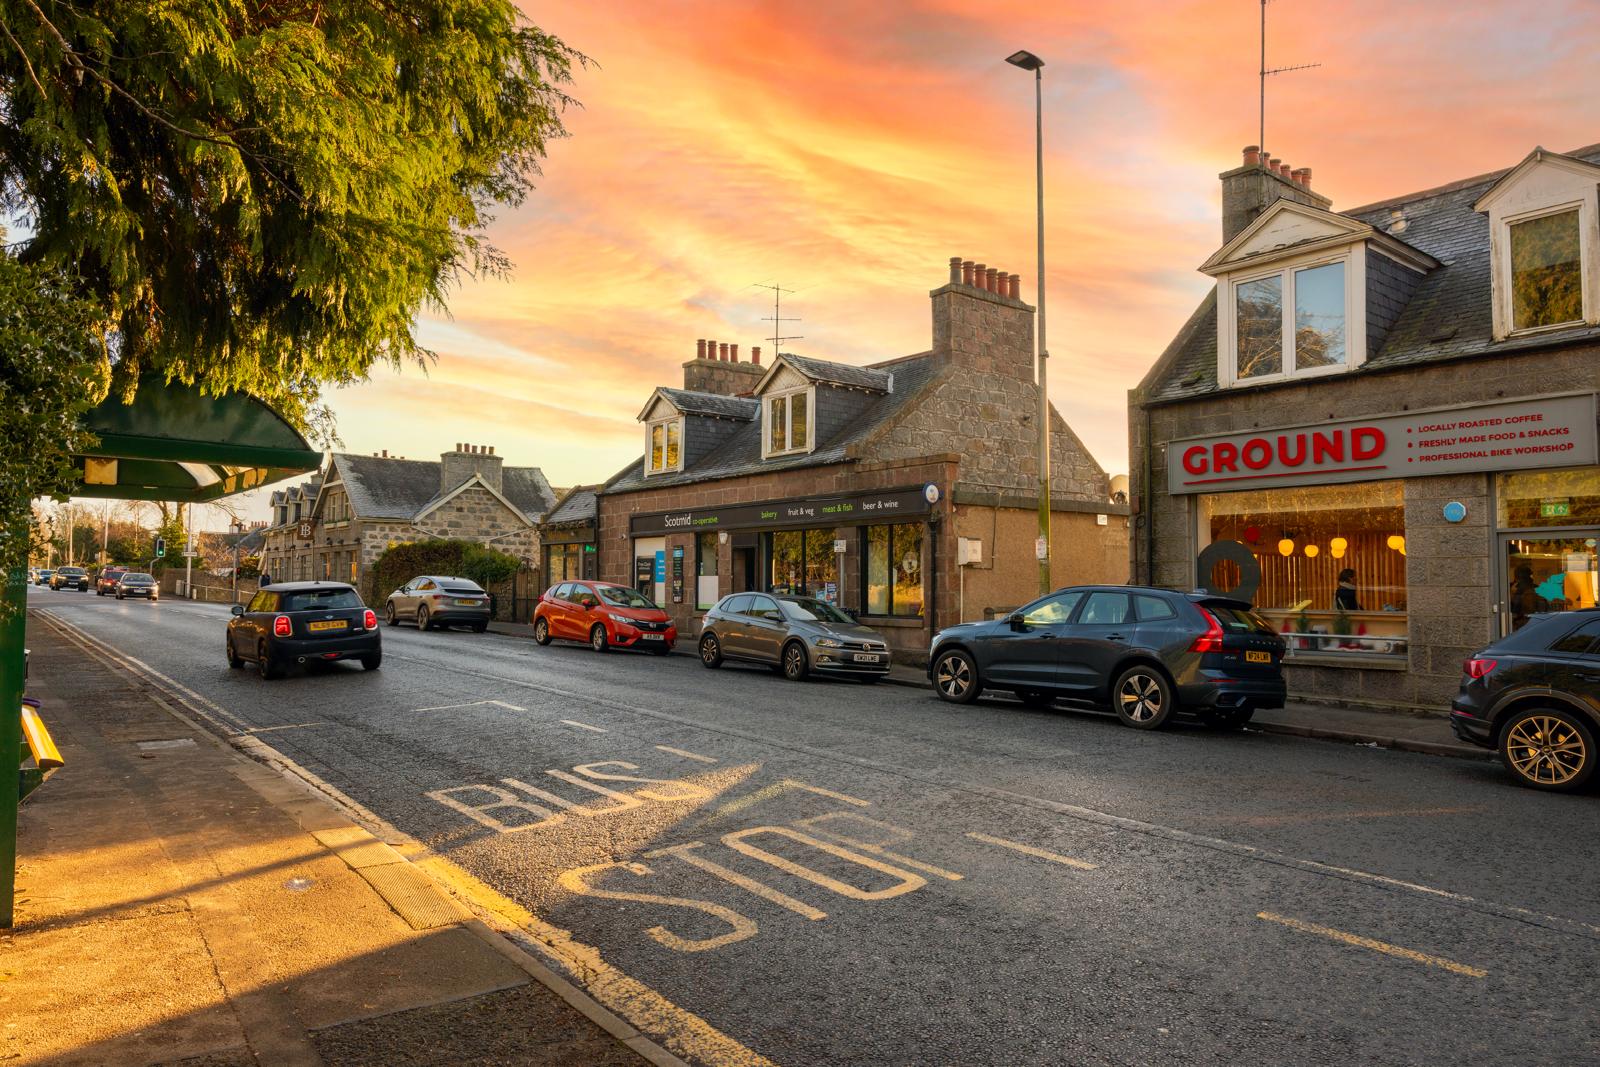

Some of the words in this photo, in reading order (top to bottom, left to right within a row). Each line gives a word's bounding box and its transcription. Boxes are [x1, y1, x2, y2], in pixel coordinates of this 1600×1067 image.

[1418, 423, 1456, 433] LOCALLY
[1458, 418, 1502, 429] ROASTED
[1504, 413, 1543, 424] COFFEE
[1418, 438, 1457, 448] FRESHLY
[1459, 435, 1486, 444] MADE
[1488, 432, 1516, 441] FOOD
[1519, 431, 1526, 439] &
[1528, 427, 1569, 438] SNACKS
[1182, 427, 1386, 475] GROUND
[1419, 450, 1489, 462] PROFESSIONAL
[1490, 448, 1512, 457] BIKE
[1515, 442, 1574, 455] WORKSHOP
[787, 508, 799, 516] fruit
[805, 508, 814, 517] veg
[843, 503, 853, 512] fish
[862, 501, 876, 510] beer
[877, 500, 883, 509] &
[884, 500, 898, 508] wine
[664, 513, 691, 527] Scotmid
[761, 511, 778, 520] bakery
[428, 759, 720, 834] BUS
[558, 810, 965, 953] STOP
